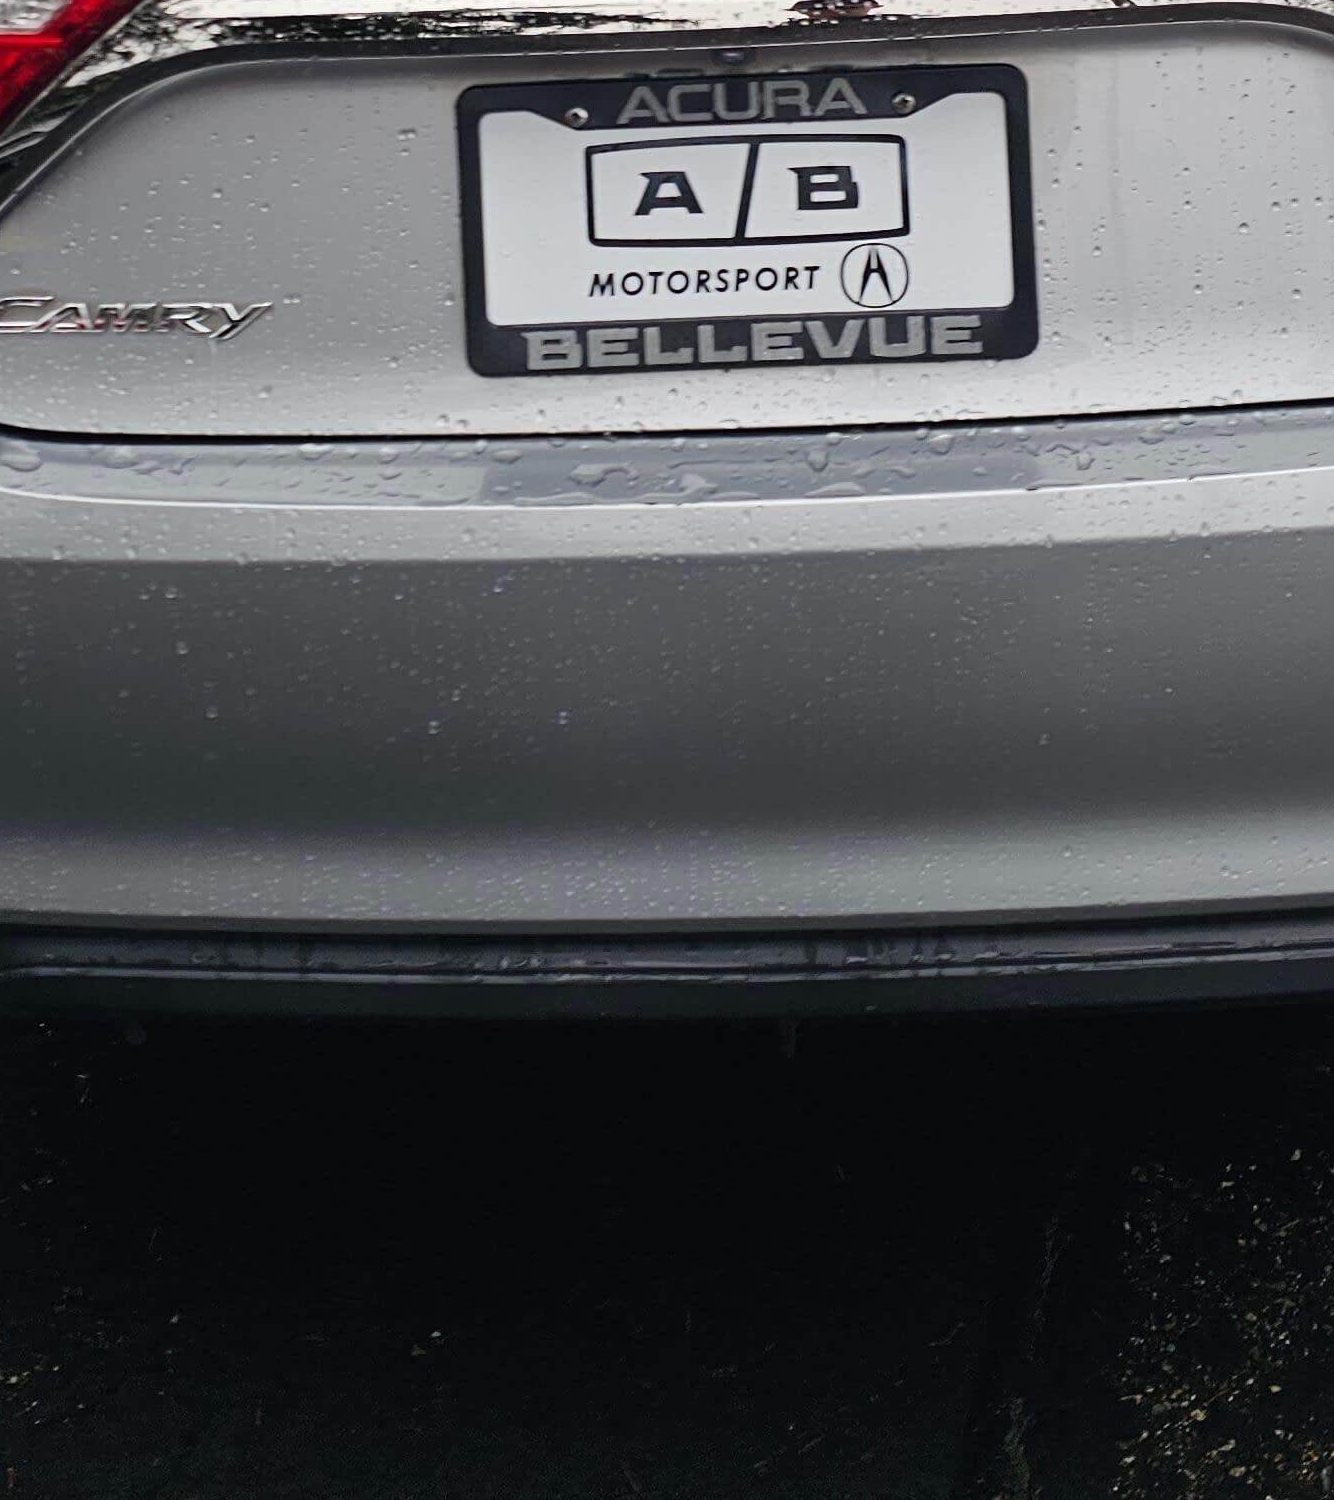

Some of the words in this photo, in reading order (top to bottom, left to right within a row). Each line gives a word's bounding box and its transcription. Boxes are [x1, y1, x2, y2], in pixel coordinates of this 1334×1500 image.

[617, 76, 868, 125] ACURA
[589, 264, 821, 298] MOTORSPORT
[520, 314, 985, 371] BELLEVUE
